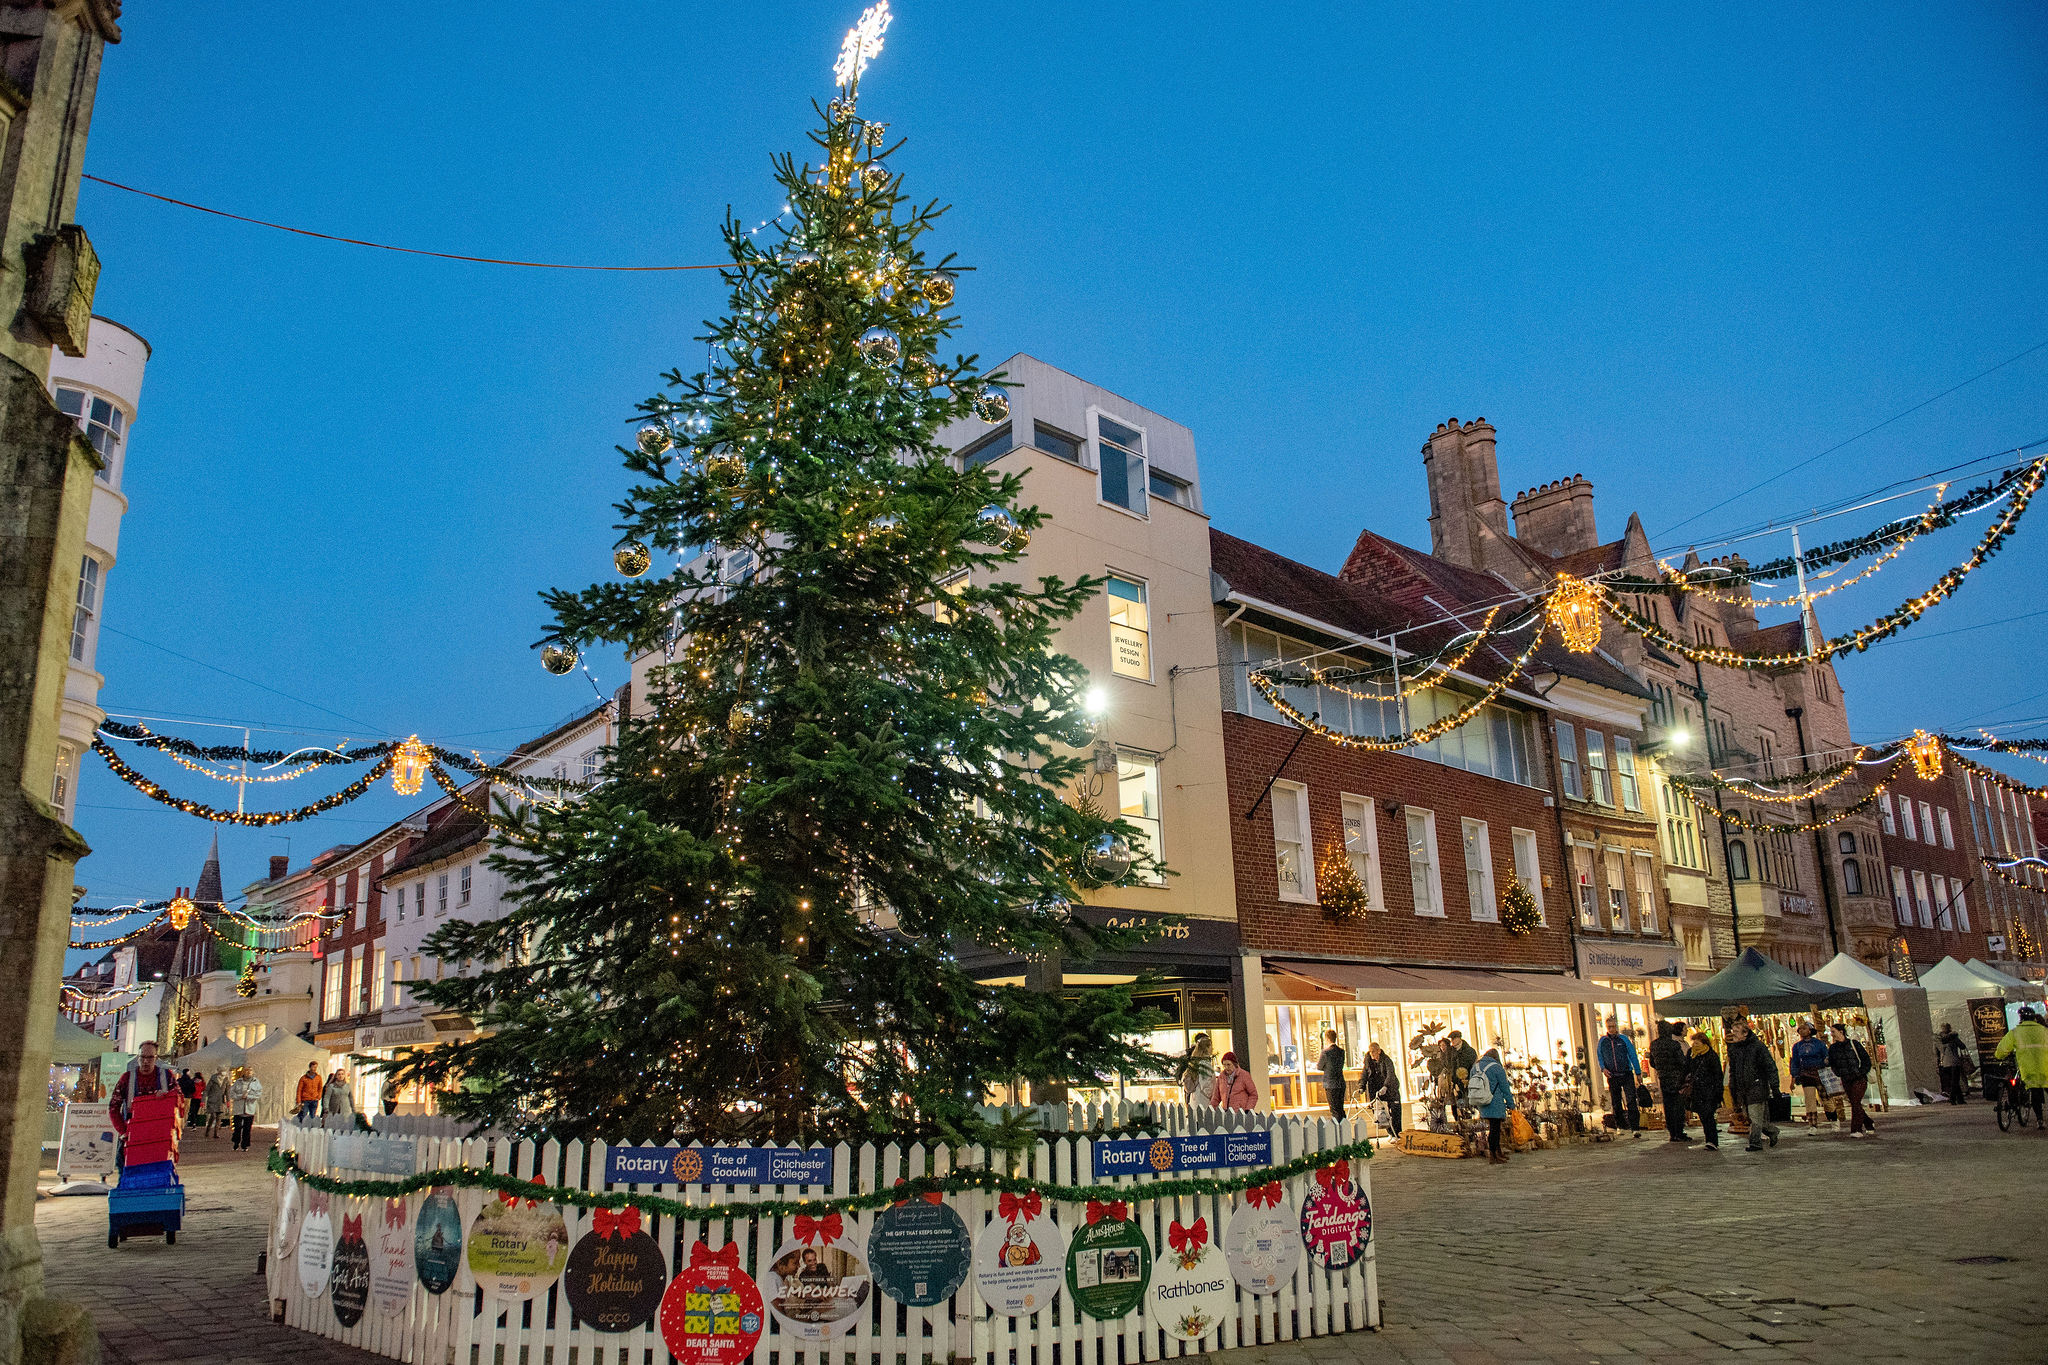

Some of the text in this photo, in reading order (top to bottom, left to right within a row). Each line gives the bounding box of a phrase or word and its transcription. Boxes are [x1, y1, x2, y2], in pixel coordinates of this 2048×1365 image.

[1115, 636, 1142, 648] JEWELLERY
[1120, 647, 1139, 657] DESIGN
[1120, 656, 1140, 666] STUDIO
[1621, 955, 1643, 969] Hospice
[382, 1025, 426, 1044] ACCESSORIZE
[1102, 1142, 1208, 1165] Rotary Tree of
[1228, 1142, 1267, 1153] Chichester
[1181, 1152, 1216, 1164] Goodwill
[1228, 1152, 1256, 1163] College
[616, 1154, 748, 1174] Rotary Tree of
[772, 1158, 825, 1170] Chichester
[711, 1166, 757, 1177] Goodwill
[772, 1168, 810, 1180] College
[1306, 1206, 1367, 1232] Fandango
[1321, 1226, 1352, 1236] DIGITAL
[380, 1234, 406, 1256] Thank
[491, 1238, 528, 1251] Rotary
[594, 1246, 638, 1271] Happy
[388, 1259, 405, 1277] you
[350, 1267, 369, 1289] Arts
[586, 1273, 643, 1297] Holidays
[778, 1284, 858, 1298] EMPOWER
[1158, 1279, 1225, 1301] Rathbones
[598, 1312, 630, 1323] ecco
[686, 1338, 735, 1348] DEAR SANTA
[702, 1347, 719, 1357] LIVE
